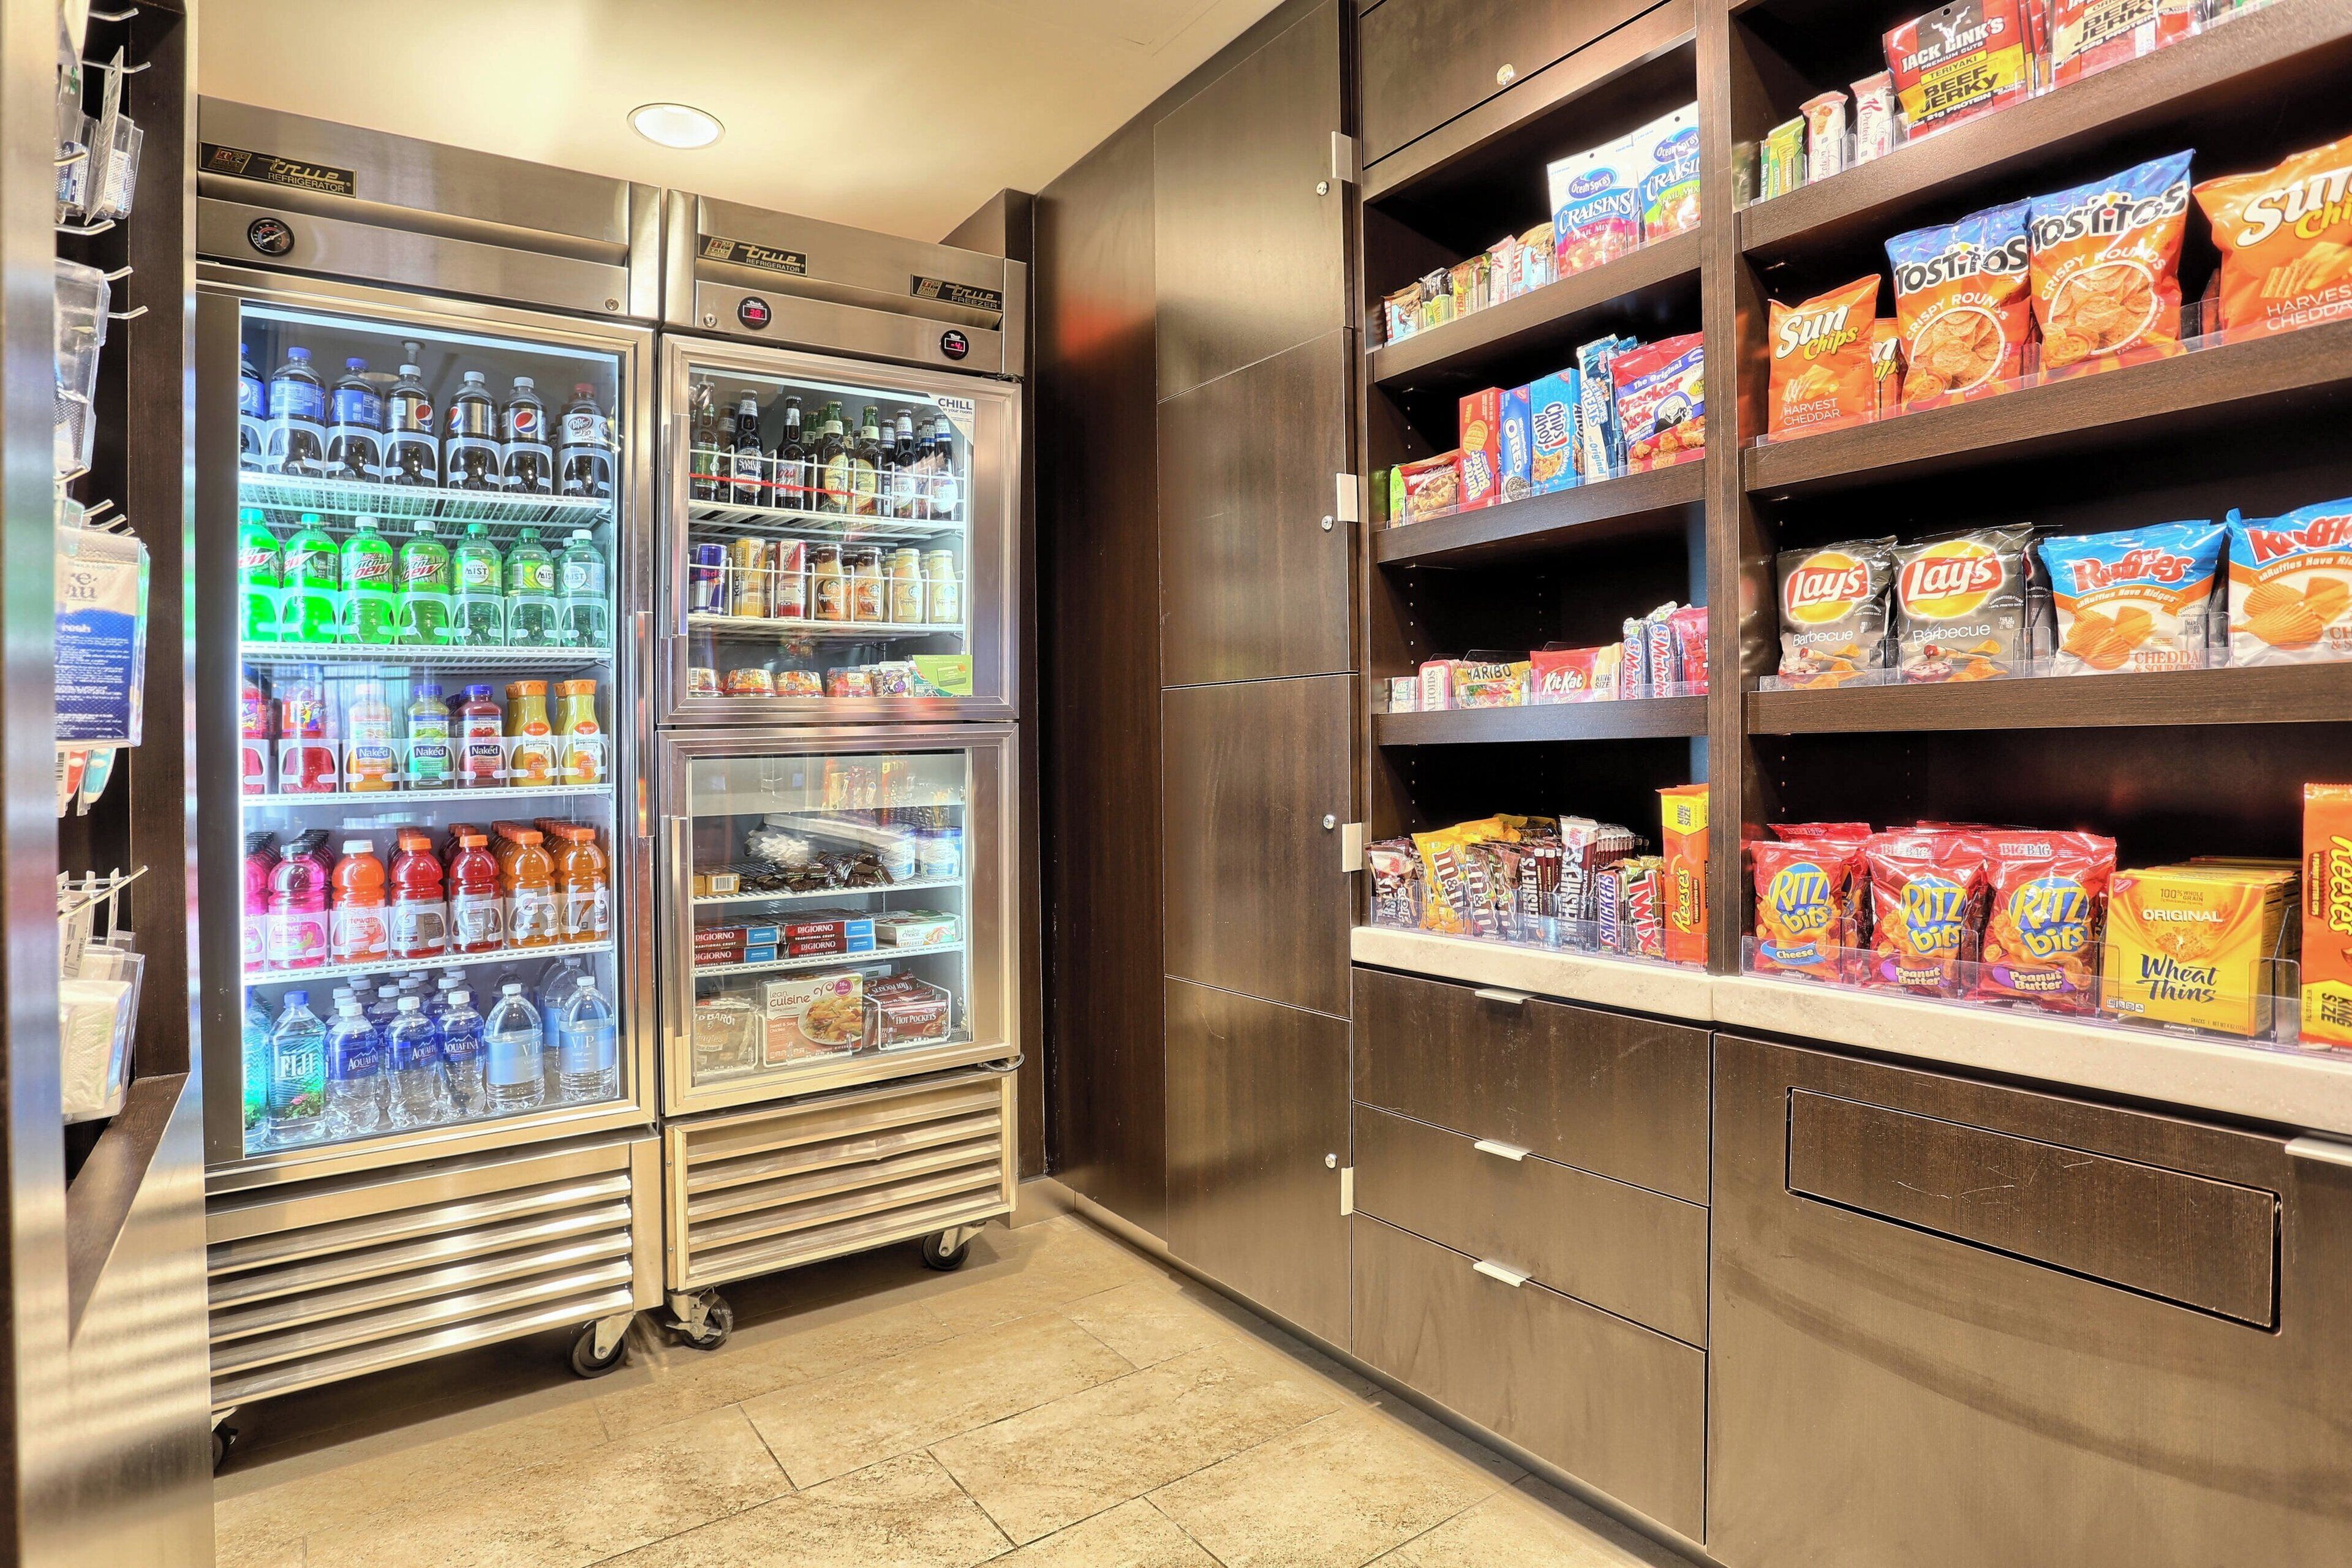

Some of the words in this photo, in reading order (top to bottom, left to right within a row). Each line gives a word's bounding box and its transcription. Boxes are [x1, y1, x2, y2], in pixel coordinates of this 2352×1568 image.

[2105, 14, 2156, 40] PROTEIN
[1901, 43, 1941, 74] JACK
[1945, 17, 2005, 54] LINK'S
[1921, 51, 1959, 70] PREMIUM
[1961, 41, 1984, 54] CUTS
[1929, 56, 1977, 78] TERIYAKI
[1920, 73, 1999, 113] JERKY
[1924, 65, 1988, 97] BEEF
[1928, 111, 1944, 121] 21g
[1947, 92, 1992, 113] PROTEIN
[1861, 109, 1872, 145] Protein
[268, 172, 345, 193] REFRIGERATOR
[1571, 180, 1591, 193] Ocean
[1589, 173, 1611, 193] Spray
[1559, 190, 1633, 235] CRAISINS
[746, 258, 801, 273] REFRIGERATOR
[2041, 254, 2087, 301] CRISPY
[951, 296, 997, 309] FREEZER
[1905, 300, 1946, 342] CRISPY
[1951, 292, 2009, 322] ROUNDS
[2266, 302, 2352, 331] CHEDDA
[1776, 304, 1850, 360] Sun
[1803, 325, 1858, 360] Chips
[1633, 379, 1648, 390] The
[1649, 360, 1683, 383] Original
[938, 398, 973, 411] CHILL
[1581, 381, 1600, 428] TREATS
[1586, 379, 1597, 394] RICE
[1594, 391, 1608, 423] KRISPIES
[1618, 377, 1684, 417] Cracker
[1784, 398, 1838, 416] HARVEST
[1544, 402, 1564, 439] Chips
[1623, 406, 1653, 434] Jack
[1784, 409, 1841, 426] CHEDDAR
[1503, 418, 1522, 473] OREO
[1534, 415, 1569, 450] Ahoy!
[1471, 451, 1491, 490] Butter
[1559, 446, 1570, 477] ORIGINAL
[1590, 442, 1605, 475] Original
[1463, 458, 1482, 501] Nutter
[465, 566, 488, 576] MIST
[700, 569, 718, 578] Red
[2074, 548, 2194, 592] Ruffles
[2305, 556, 2334, 568] Have
[1789, 565, 1865, 609] Lay's
[1906, 552, 1999, 603] Lay's
[2118, 587, 2141, 597] Have
[2143, 587, 2176, 603] Ridges
[1654, 627, 1668, 638] 3
[1792, 629, 1853, 647] Barbecue
[1913, 624, 1991, 644] Barbecue
[1628, 640, 1639, 652] 3
[1467, 664, 1512, 680] HARIBO
[1596, 674, 1612, 682] KING
[359, 747, 388, 758] Naked
[415, 746, 445, 757] Naked
[472, 745, 499, 755] Naked
[1806, 827, 1822, 835] BAG
[1906, 845, 1929, 858] BAG
[2000, 843, 2024, 856] BIG
[2024, 844, 2051, 857] BAG
[1521, 858, 1539, 928] HERSHEY'S
[1672, 867, 1692, 935] Reese's
[1770, 870, 1828, 912] RITZ
[2160, 888, 2184, 899] 100%
[2311, 880, 2320, 899] BUTTER
[1398, 886, 1412, 924] drops
[1600, 874, 1615, 944] SNICKERS
[1629, 872, 1662, 953] TWIX
[1901, 886, 1967, 928] RITZ
[2010, 885, 2088, 929] RITZ
[2143, 909, 2224, 923] ORIGINAL
[797, 923, 834, 935] DIGIORNO
[1782, 906, 1830, 932] bits
[695, 931, 734, 941] DIGIORNO
[801, 940, 836, 951] DIGIORNO
[1911, 925, 1962, 951] bits
[2024, 925, 2086, 955] bits
[1776, 948, 1814, 959] Cheese
[1895, 968, 1942, 979] Peanut
[1898, 975, 1942, 987] Butter
[2009, 969, 2063, 983] Peanut
[2140, 953, 2222, 986] Wheat
[871, 984, 896, 994] POCKETS
[2014, 979, 2063, 991] Butter
[2135, 979, 2217, 1004] Thins
[769, 994, 811, 1008] cuisine
[2320, 992, 2337, 1025] SIZE
[895, 1016, 910, 1025] HOT
[910, 1012, 937, 1023] POCKETS
[443, 1037, 480, 1053] AQUAFINA
[279, 1052, 314, 1078] FIJI
